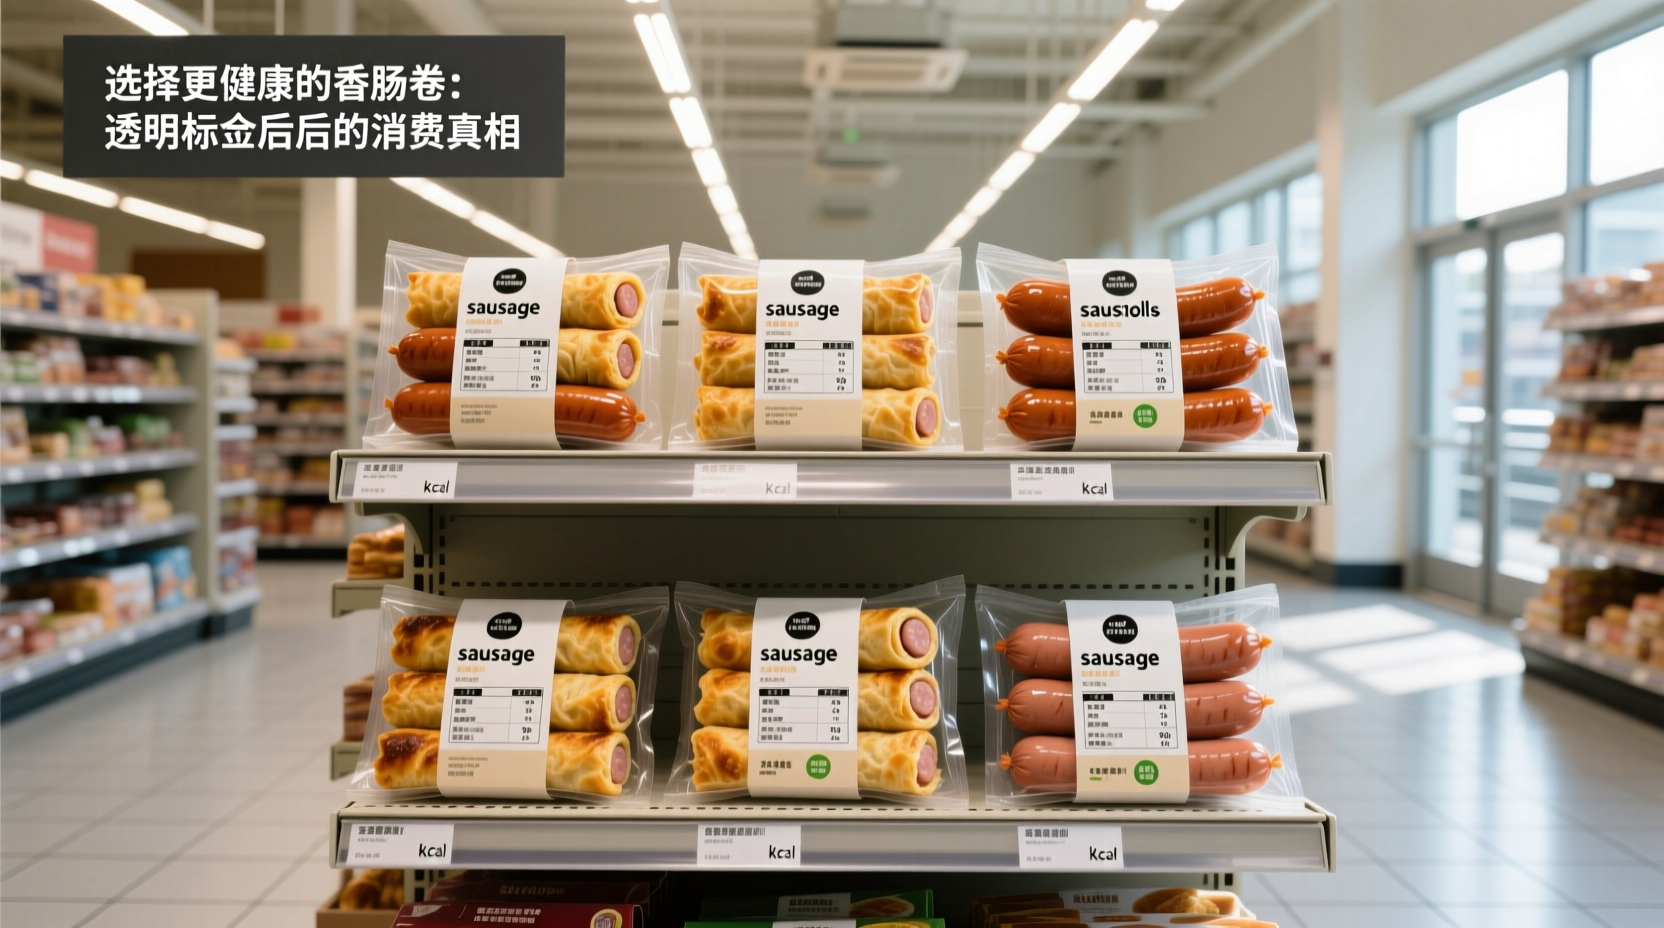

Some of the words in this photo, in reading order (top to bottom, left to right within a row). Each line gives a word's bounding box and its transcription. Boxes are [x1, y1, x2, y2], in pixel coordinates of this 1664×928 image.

[466, 302, 541, 320] sausage
[765, 304, 840, 321] sausage
[423, 480, 450, 494] kcal
[1082, 482, 1108, 495] kcal
[457, 648, 535, 666] sausage
[760, 648, 838, 666] sausage
[1080, 653, 1160, 671] sausage
[418, 843, 447, 858] kcal
[768, 844, 796, 860] kcal
[1089, 846, 1117, 861] kcal
